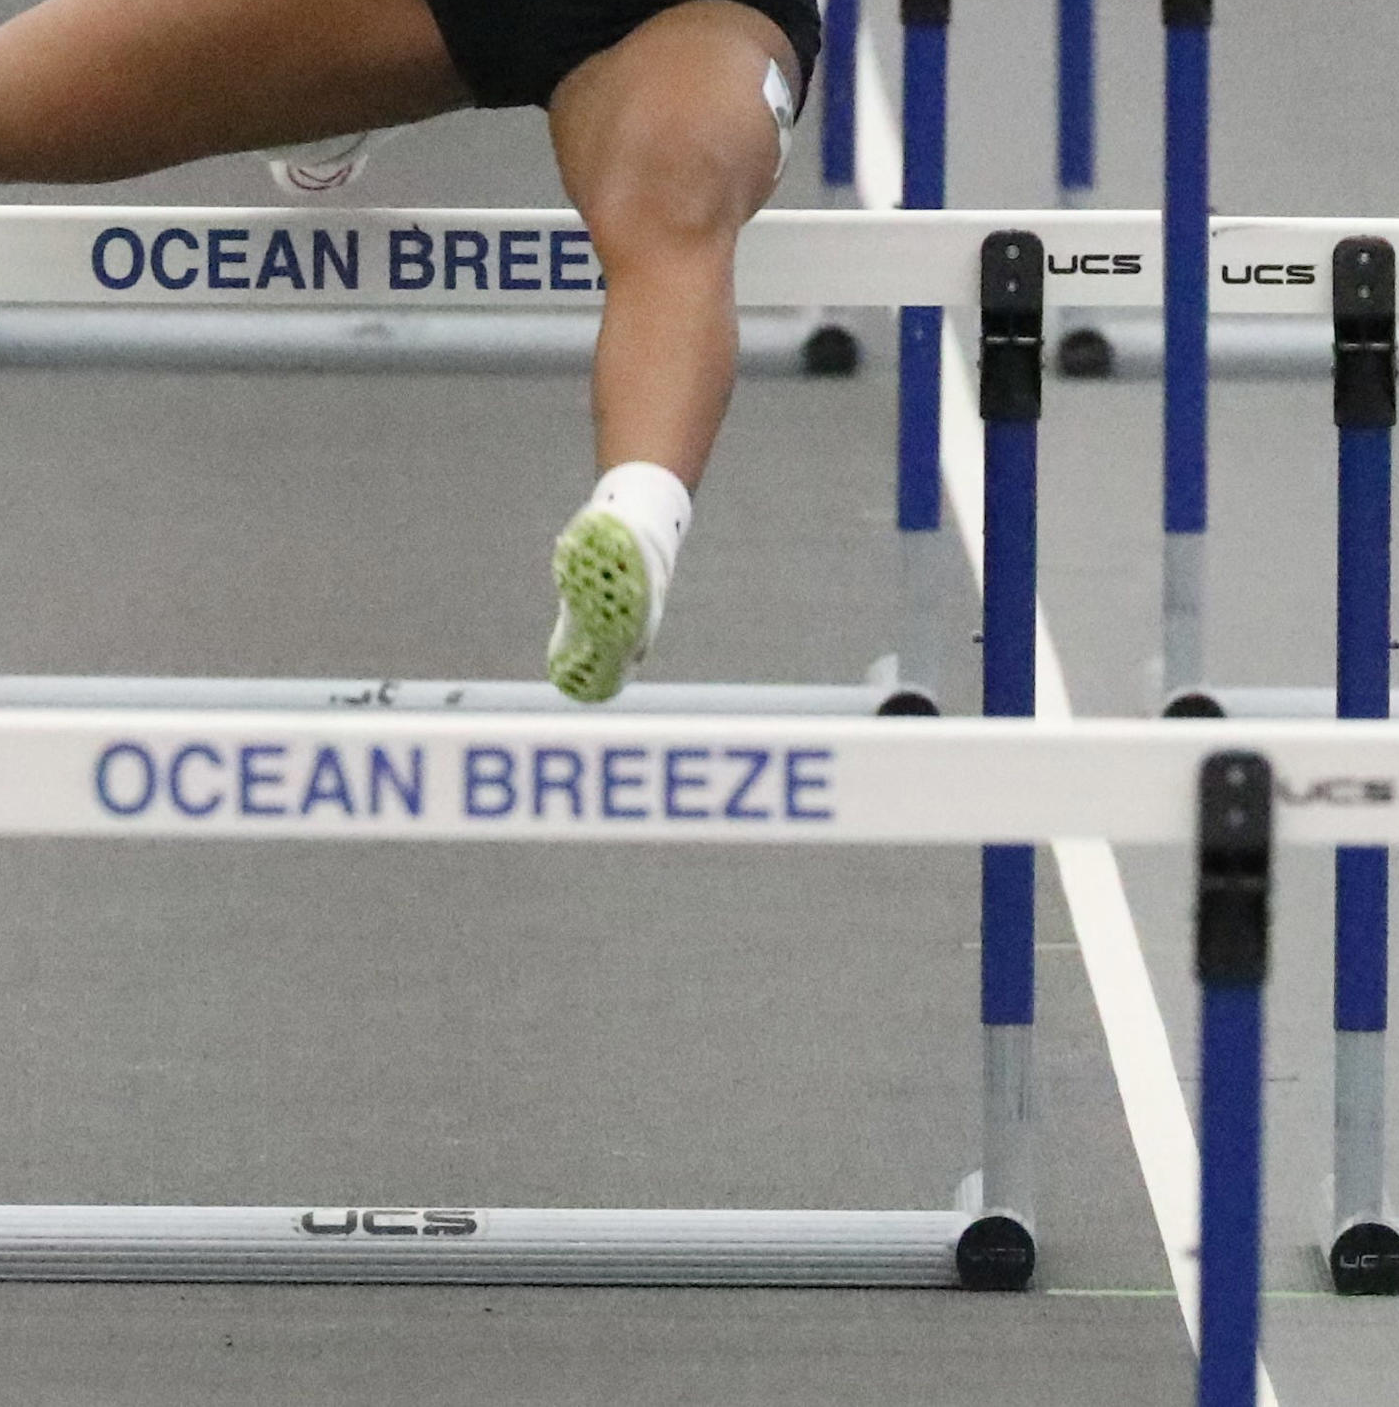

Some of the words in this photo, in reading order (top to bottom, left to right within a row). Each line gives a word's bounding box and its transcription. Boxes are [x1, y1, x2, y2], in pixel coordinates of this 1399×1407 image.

[91, 226, 360, 291] OCEAN
[388, 230, 606, 291] BREE
[1048, 253, 1142, 275] UCS
[1221, 263, 1316, 285] UCS
[93, 742, 424, 817] OCEAN
[463, 746, 835, 820] BREEZE
[1278, 777, 1398, 807] UCS
[301, 1209, 478, 1236] UCS
